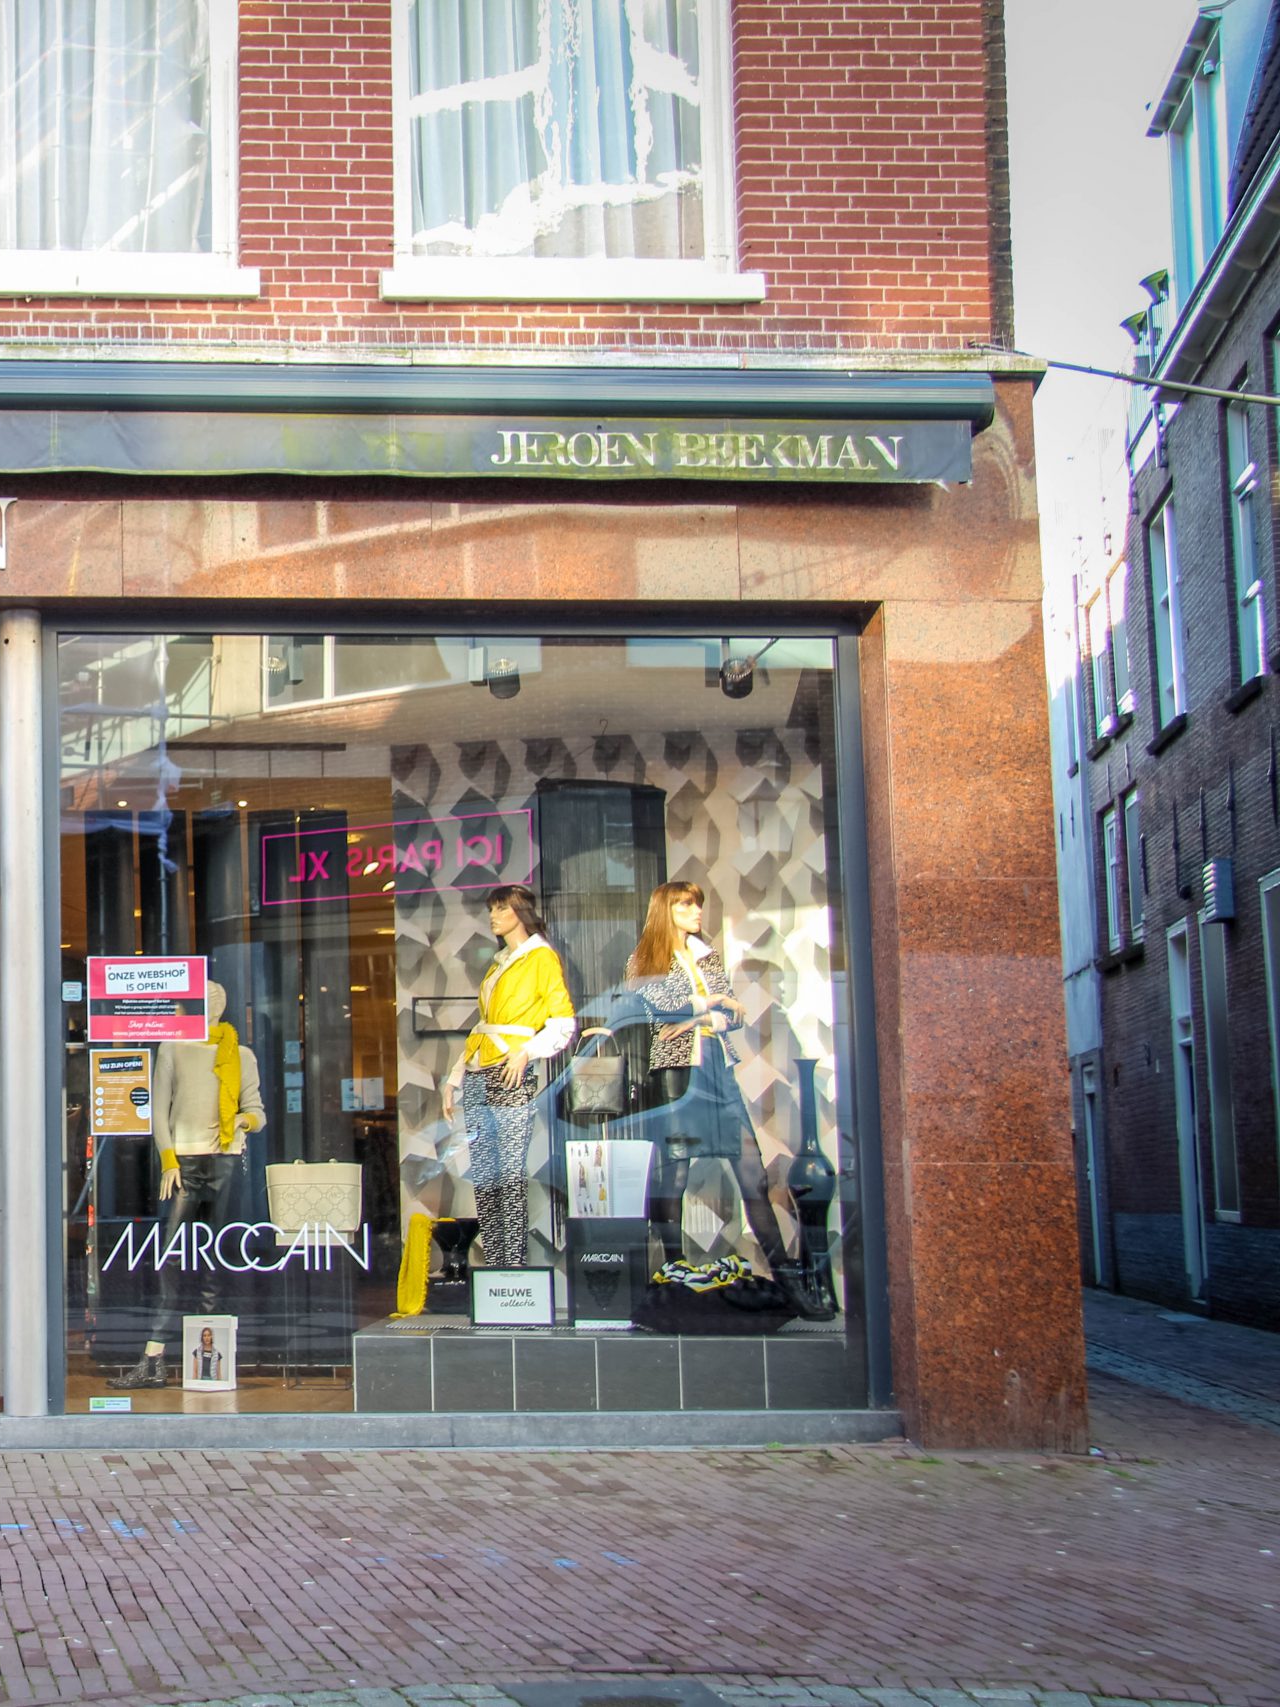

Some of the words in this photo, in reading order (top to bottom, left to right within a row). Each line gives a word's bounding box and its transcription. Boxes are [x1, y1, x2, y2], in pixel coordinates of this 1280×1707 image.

[490, 430, 659, 468] JEROEN
[674, 431, 904, 471] BEEKMAN
[108, 971, 135, 981] ONZE
[138, 969, 186, 980] WEBSHOP
[126, 983, 134, 992] IS
[137, 982, 168, 991] OPEN!
[489, 1288, 532, 1298] NIEUWE
[500, 1299, 536, 1308] collectie
